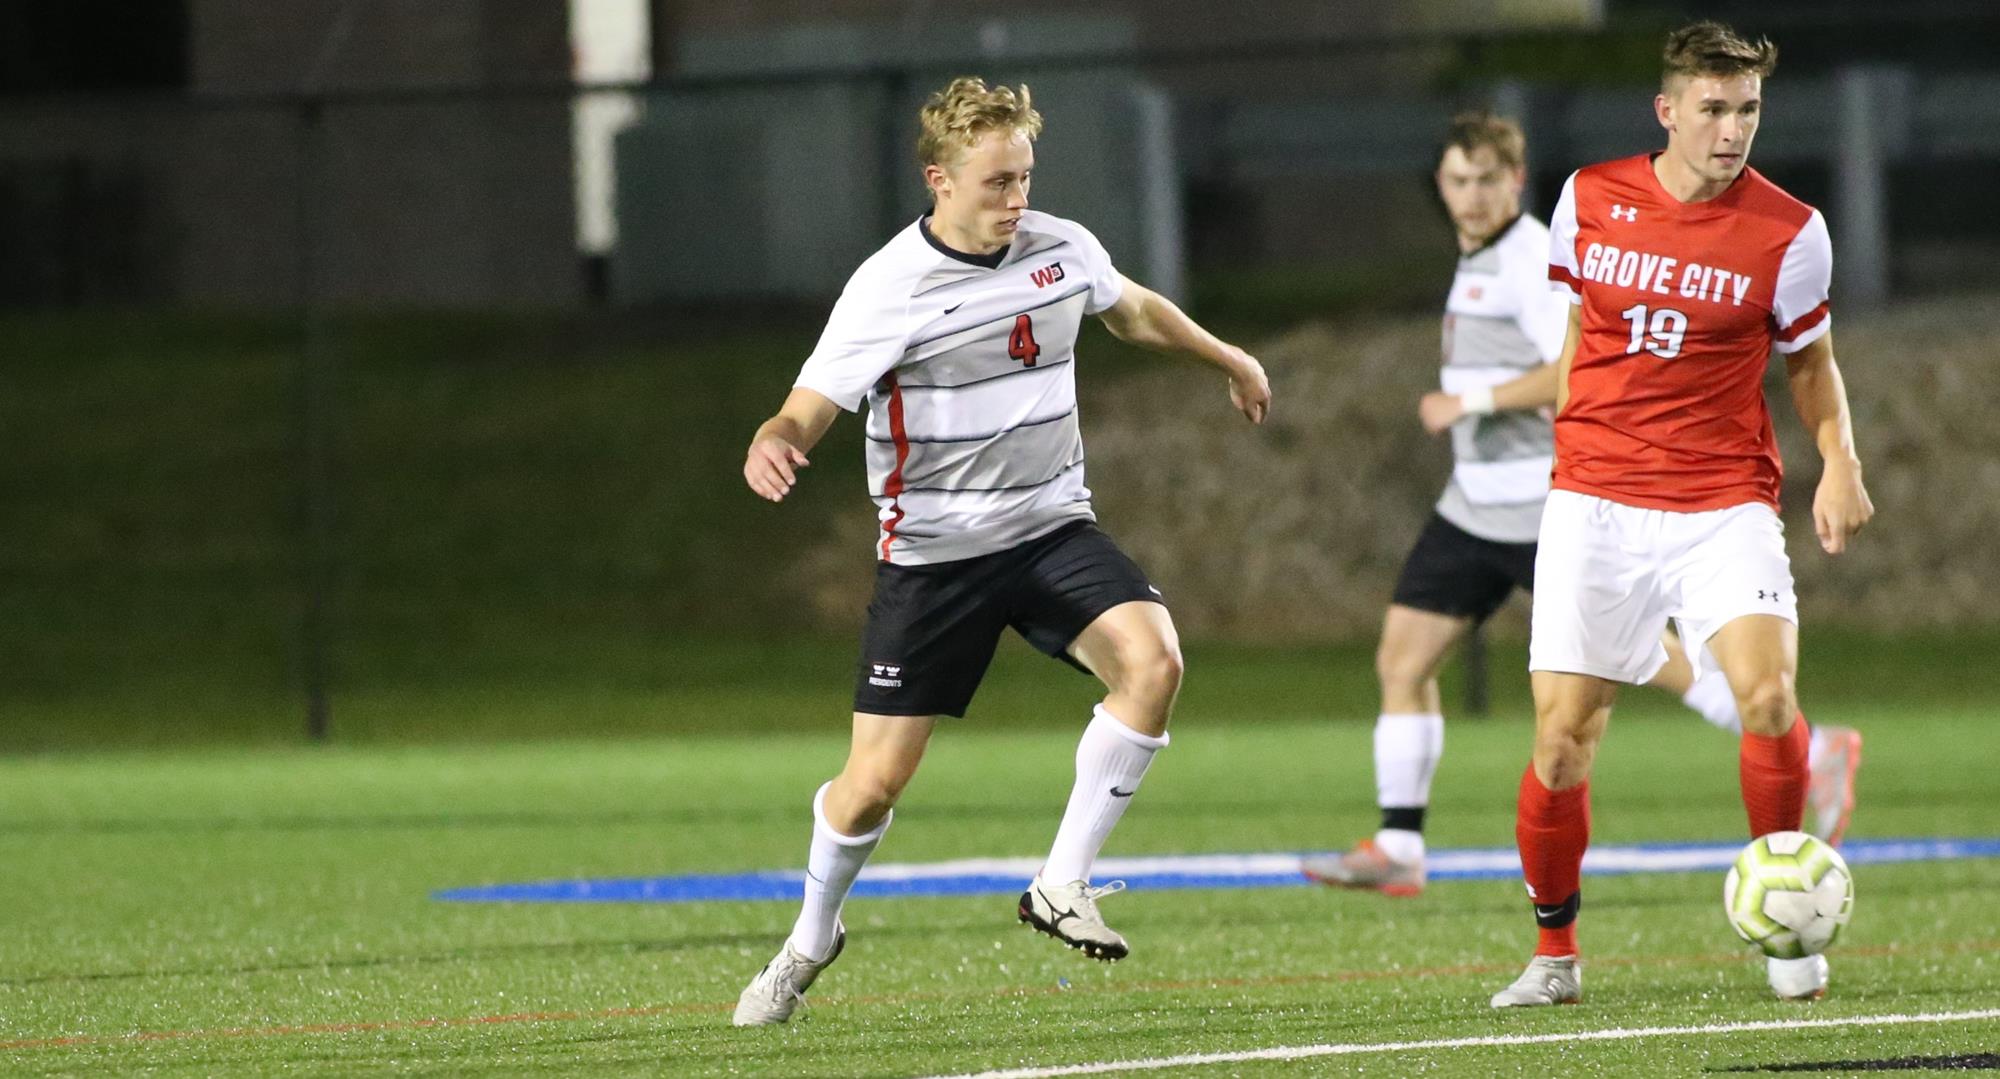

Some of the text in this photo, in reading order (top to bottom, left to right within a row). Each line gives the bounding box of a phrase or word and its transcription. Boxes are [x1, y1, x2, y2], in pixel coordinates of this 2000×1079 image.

[1582, 242, 1752, 306] GROVE CITY
[1008, 313, 1040, 367] 4
[1621, 304, 1688, 359] 19
